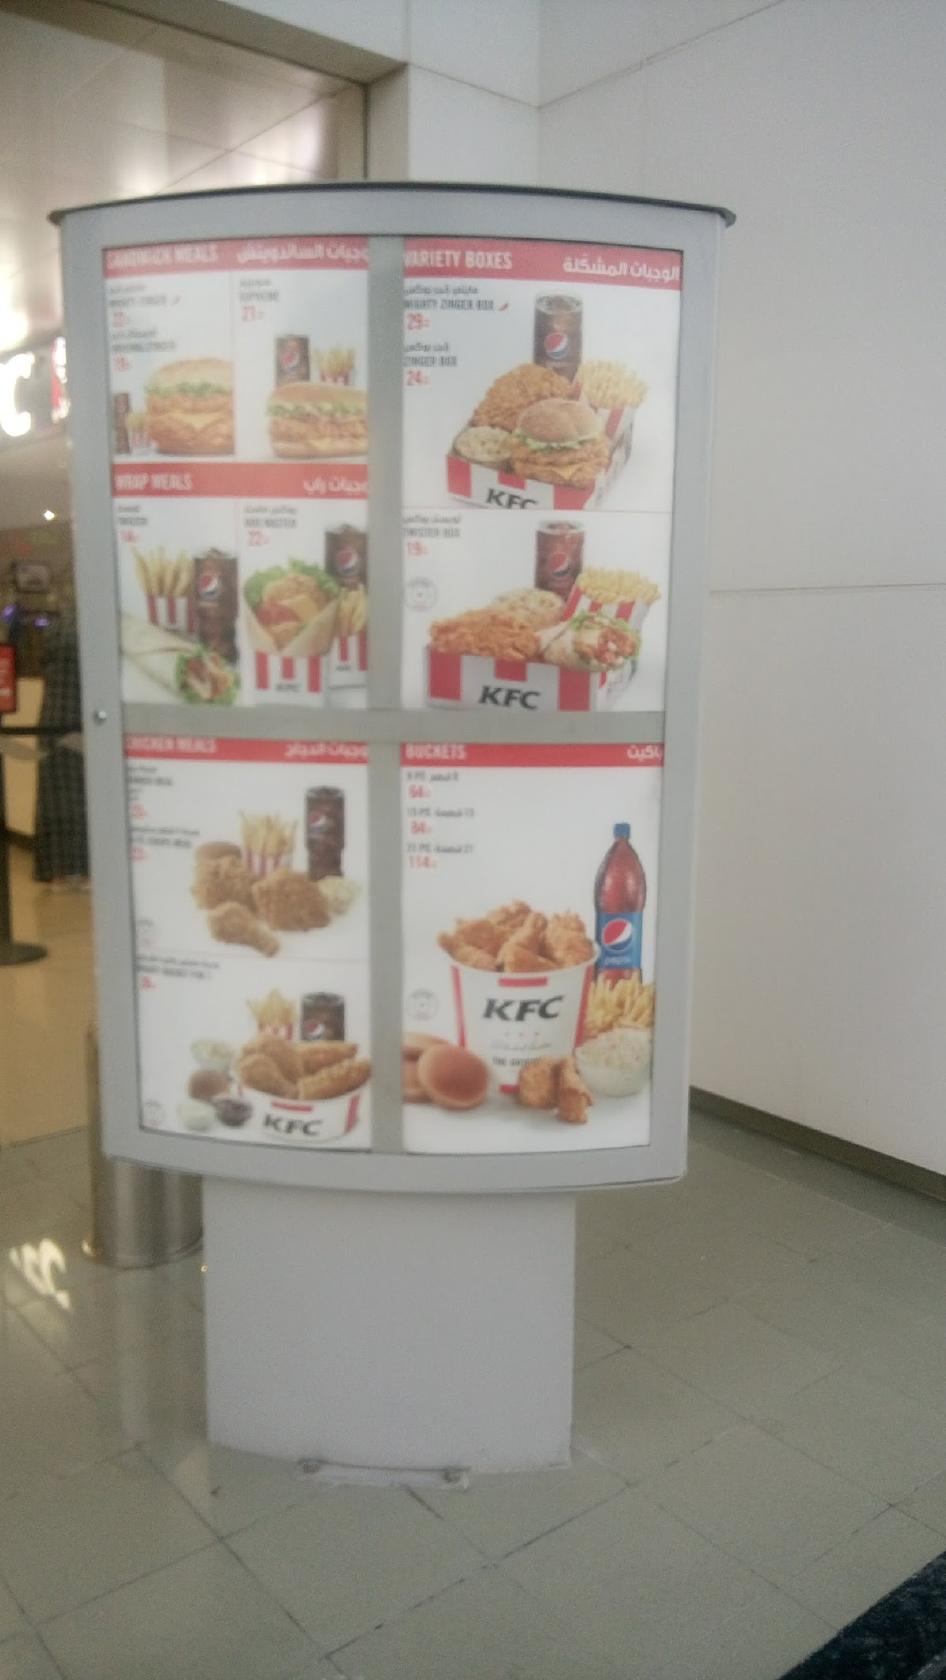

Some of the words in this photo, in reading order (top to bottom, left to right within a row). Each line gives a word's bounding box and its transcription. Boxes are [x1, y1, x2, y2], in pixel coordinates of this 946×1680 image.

[404, 249, 461, 268] VARIETY
[465, 251, 513, 270] BOXES
[562, 252, 628, 277] المشكلة
[630, 260, 681, 284] الوجبات
[486, 488, 540, 509] KFC
[478, 685, 541, 711] KFC
[404, 743, 467, 760] BUCKETS
[482, 994, 565, 1022] KFC
[262, 1113, 323, 1137] KFC
